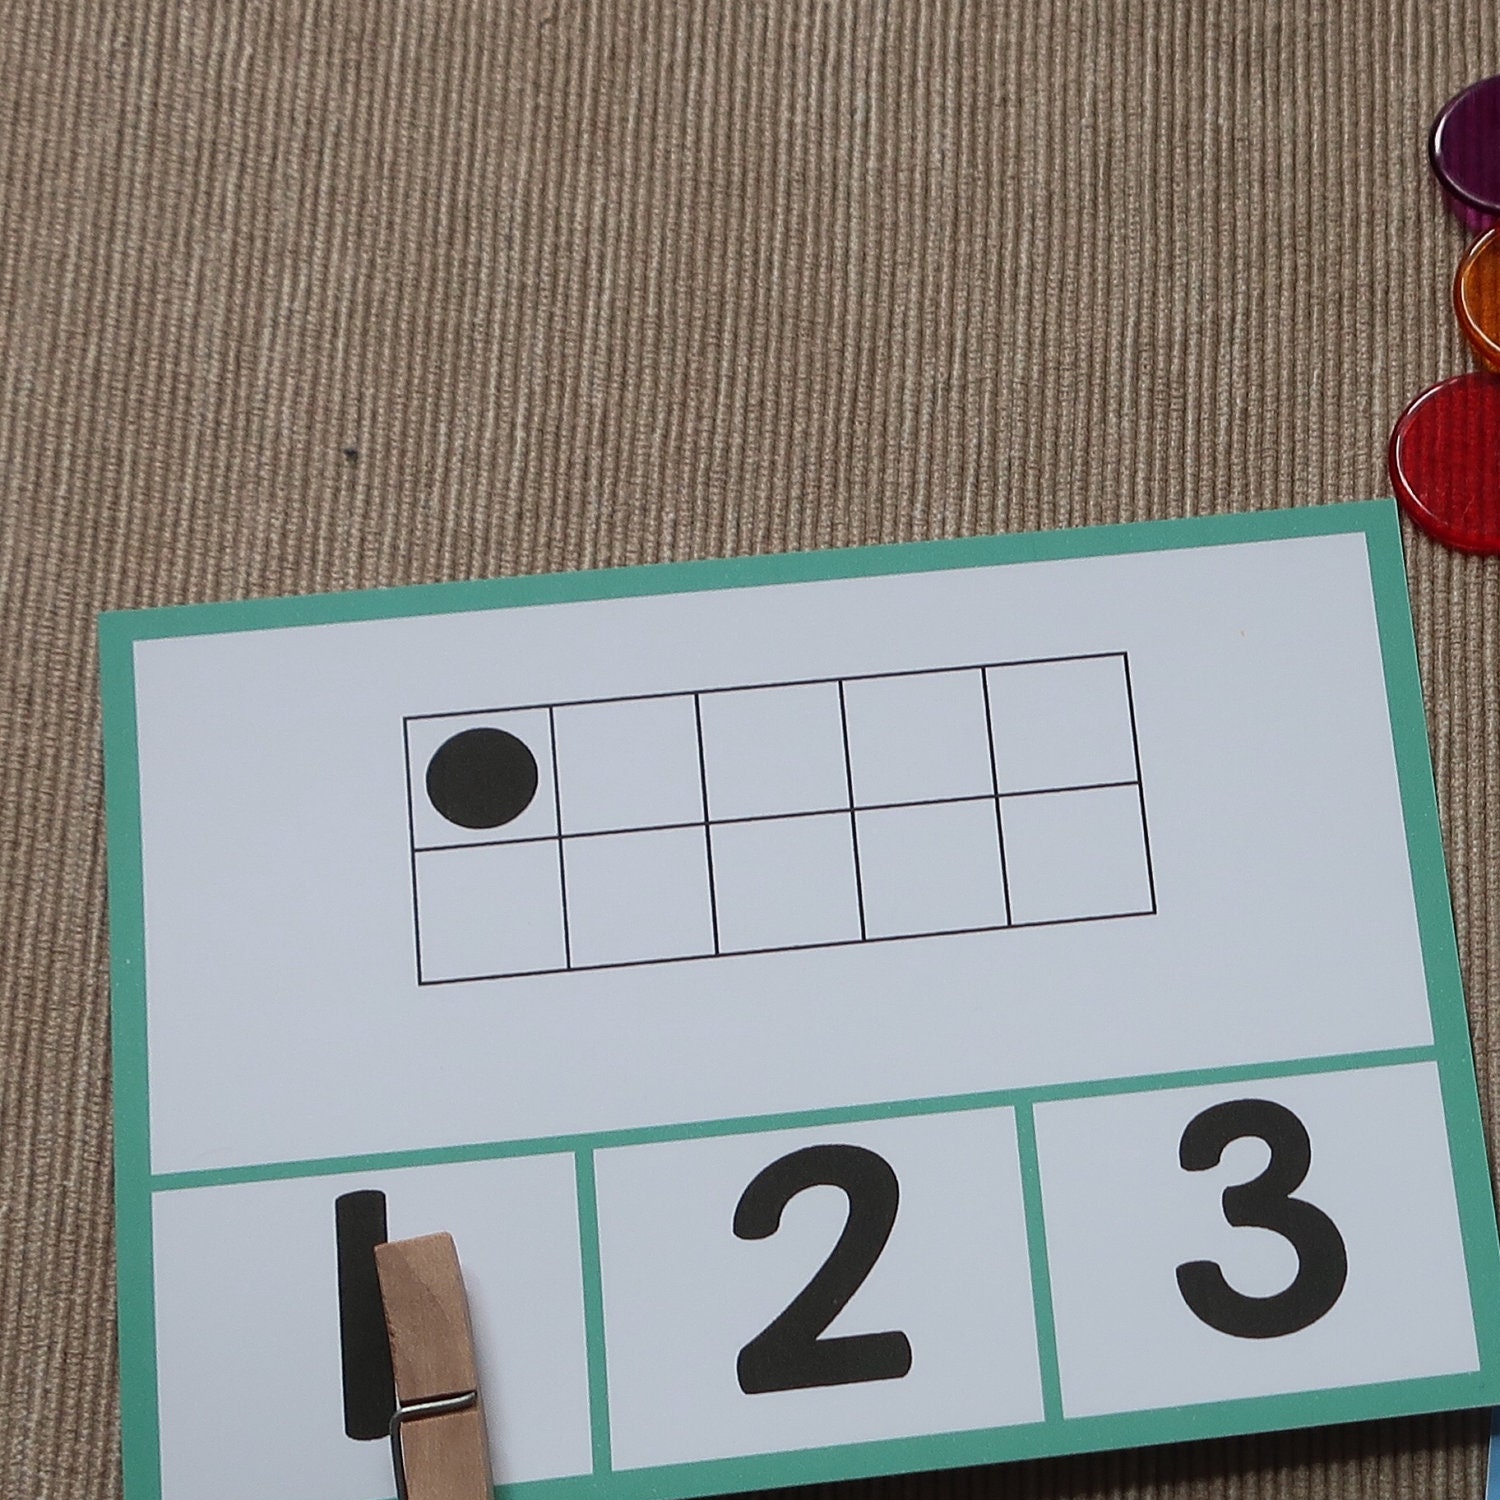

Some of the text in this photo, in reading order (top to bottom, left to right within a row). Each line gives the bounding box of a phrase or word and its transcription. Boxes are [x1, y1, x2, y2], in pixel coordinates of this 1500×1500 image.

[335, 1099, 1348, 1441] 1 2 3
